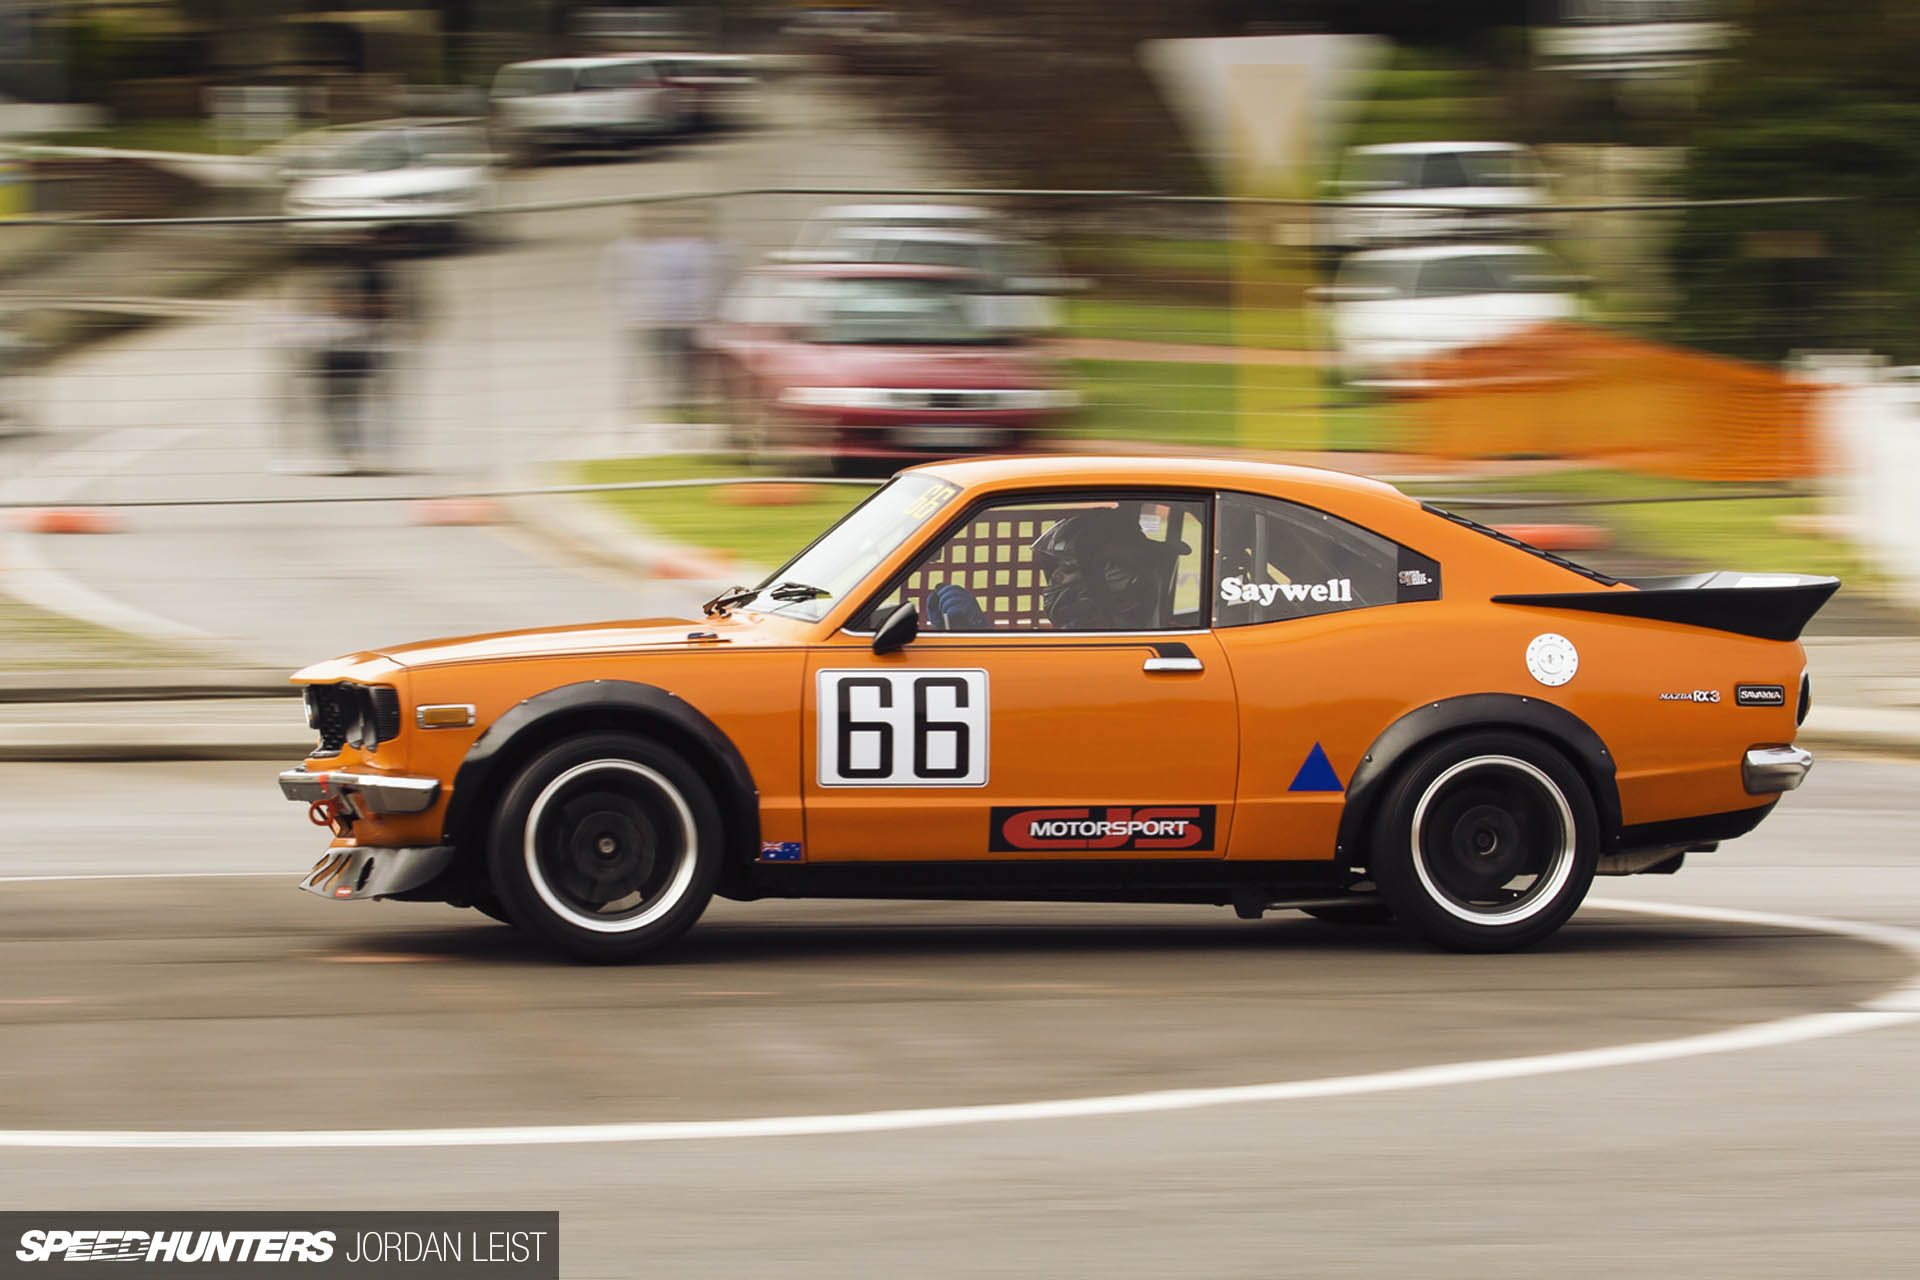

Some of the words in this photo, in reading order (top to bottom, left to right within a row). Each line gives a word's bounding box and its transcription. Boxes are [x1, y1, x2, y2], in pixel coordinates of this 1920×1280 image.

[1220, 576, 1353, 606] Saywell
[837, 677, 970, 779] 66
[1029, 820, 1190, 837] MOTORSPORT
